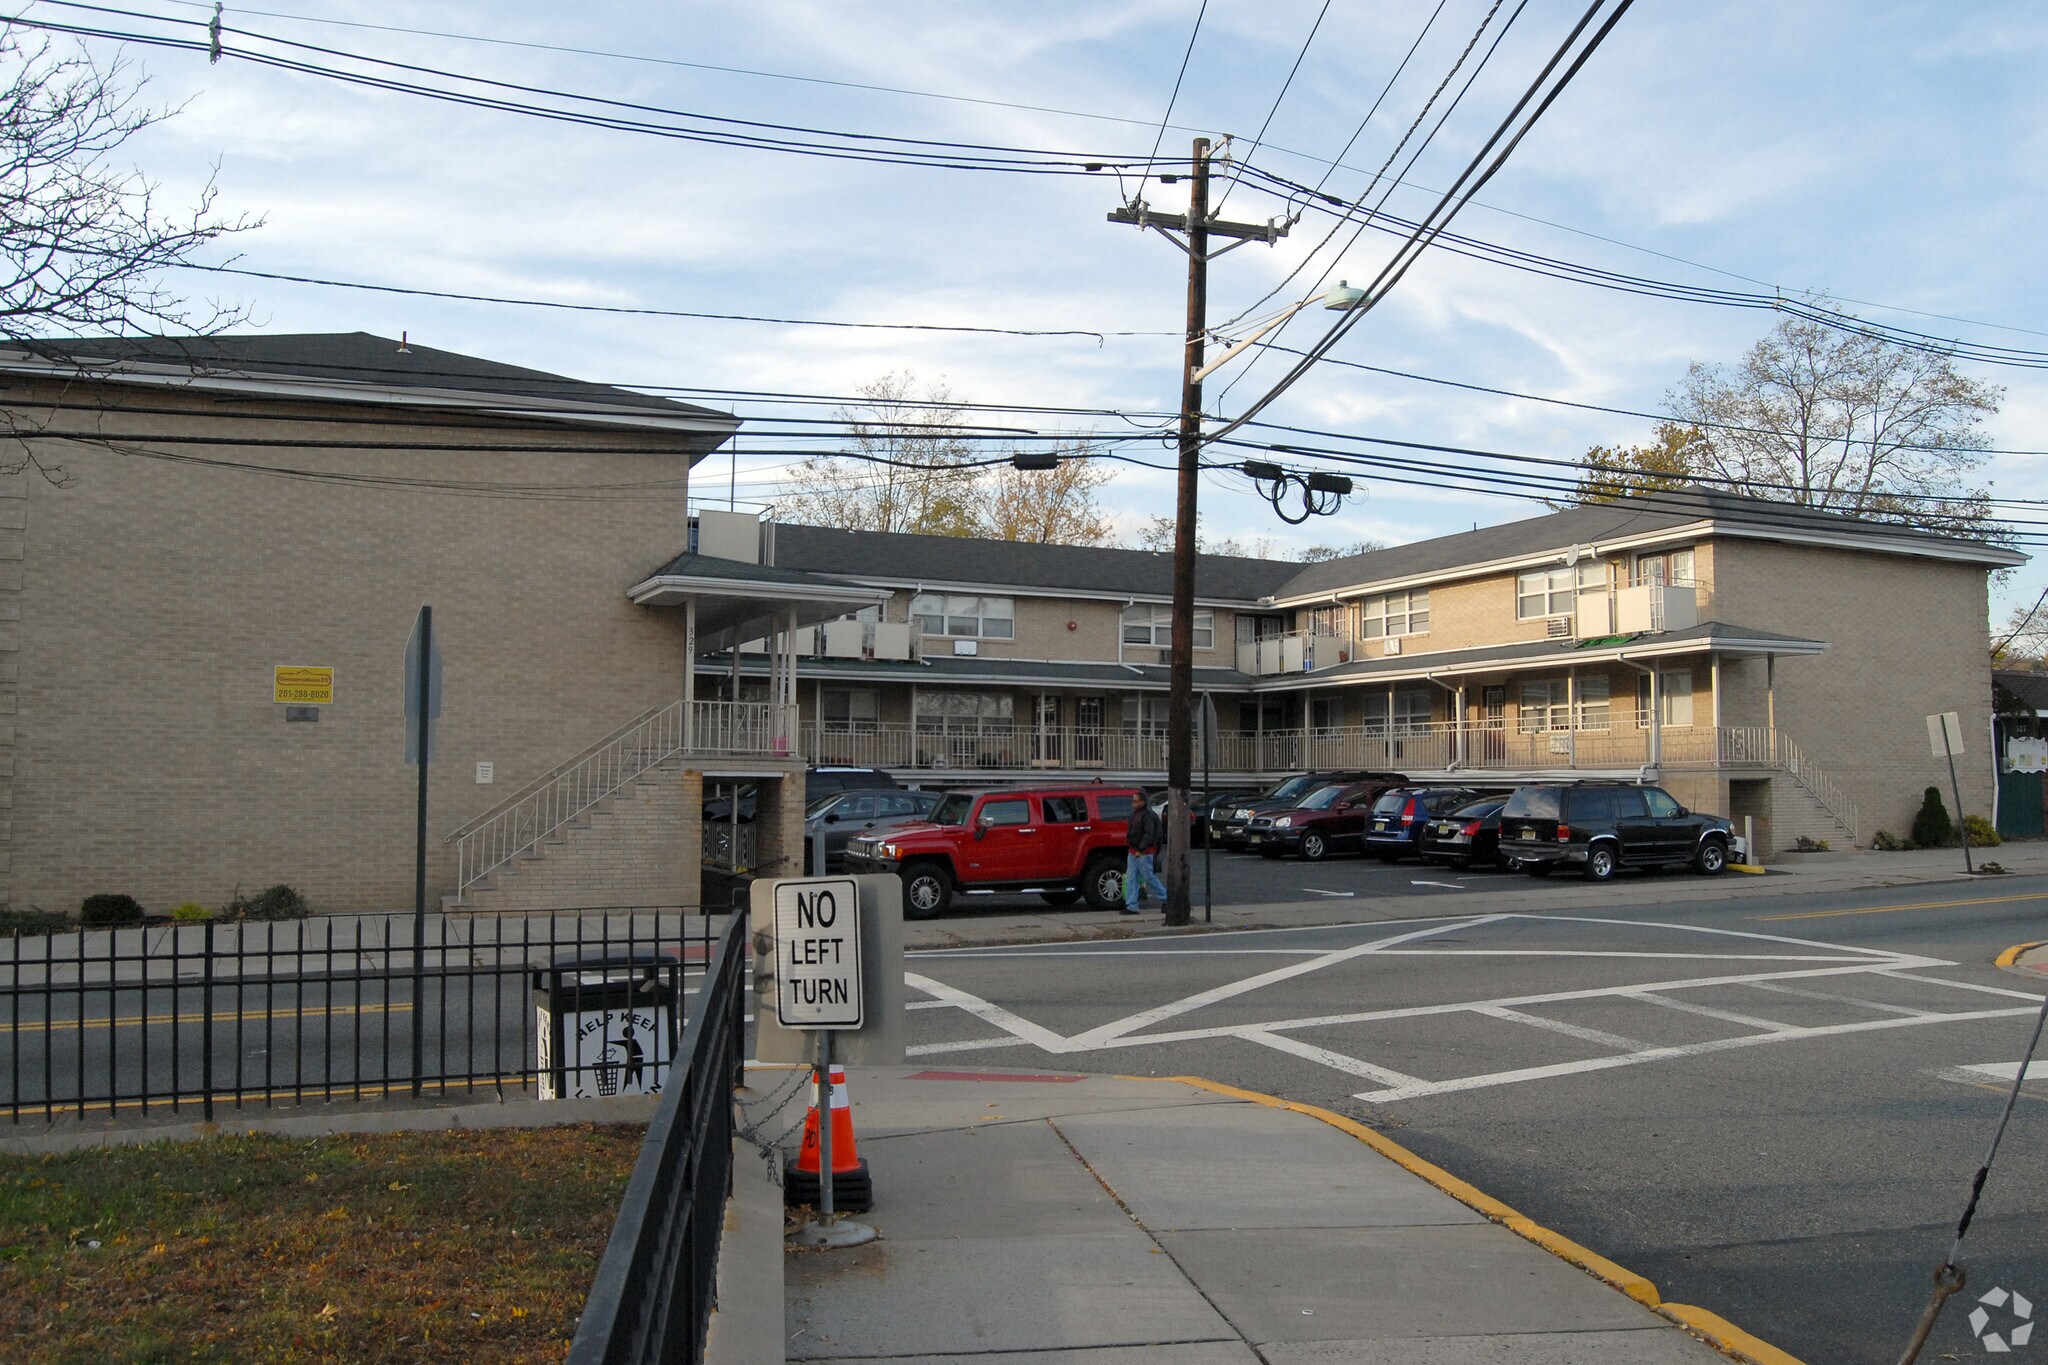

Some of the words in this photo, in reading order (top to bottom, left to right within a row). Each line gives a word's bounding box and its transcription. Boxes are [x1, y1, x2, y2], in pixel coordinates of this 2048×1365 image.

[797, 890, 837, 929] NO
[791, 938, 844, 965] LEFT
[789, 978, 848, 1005] TURN
